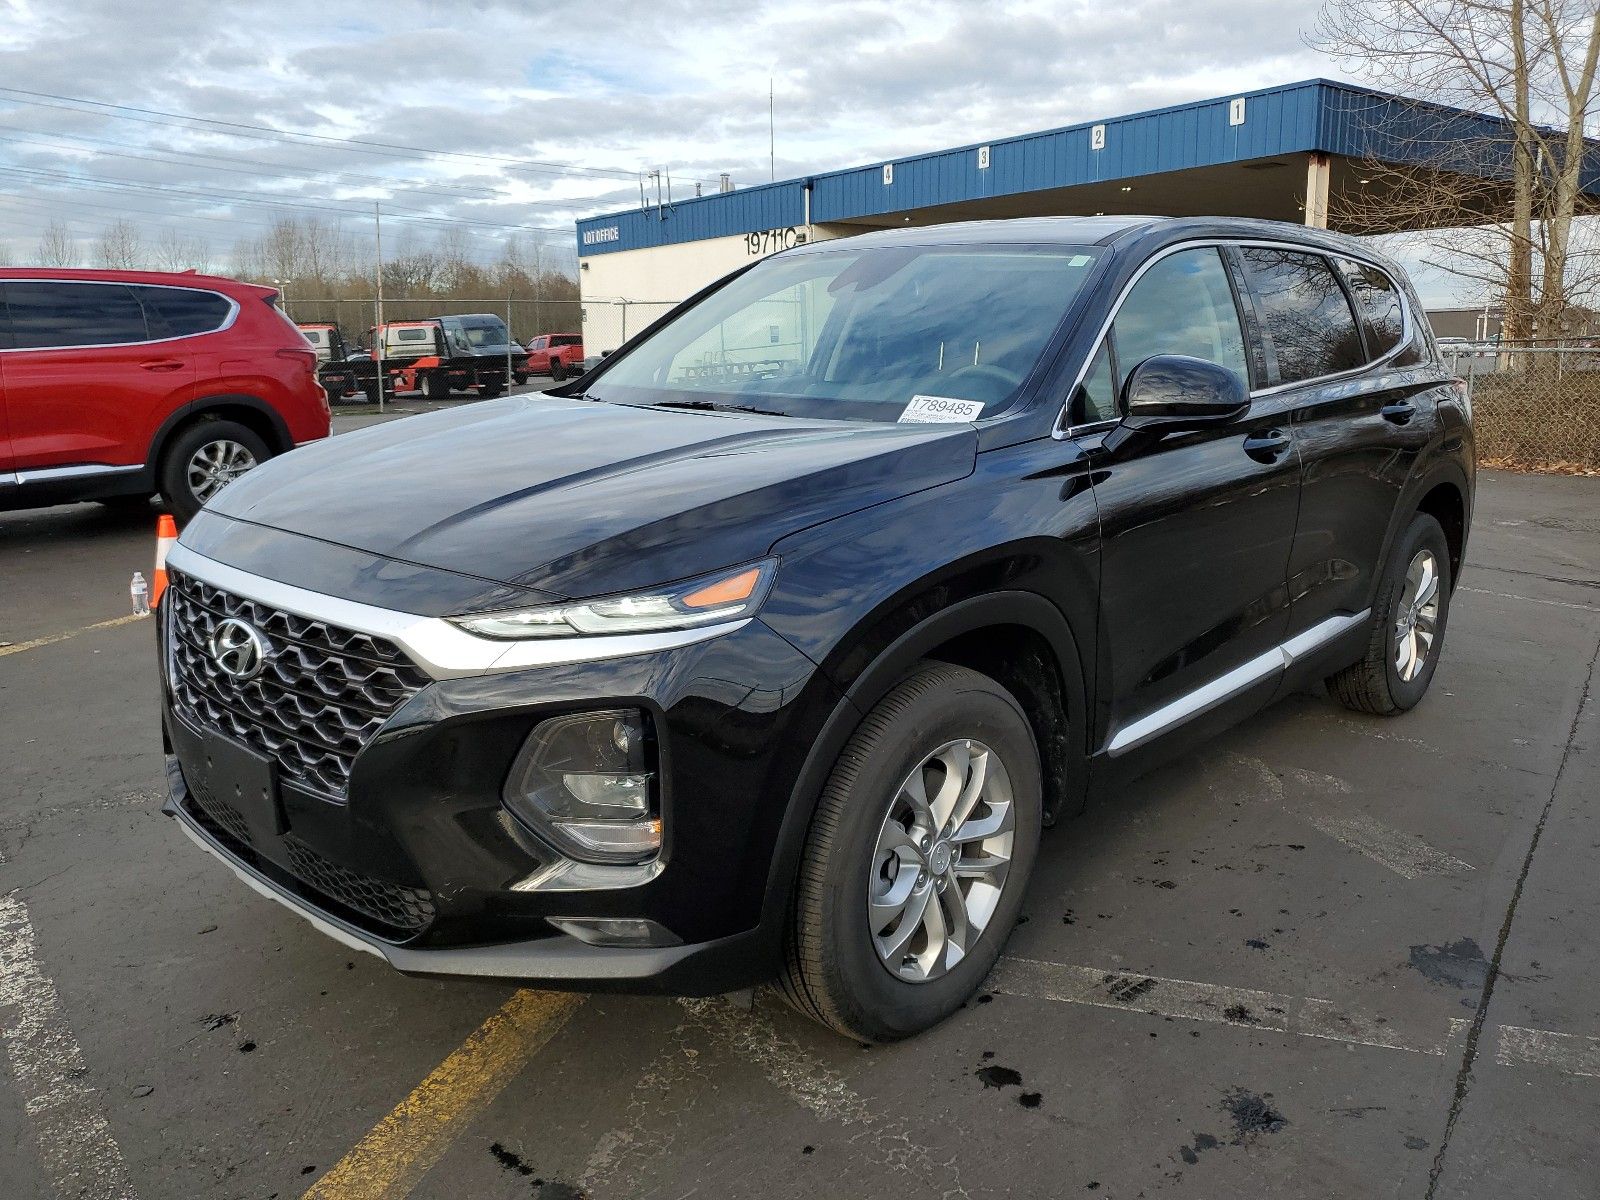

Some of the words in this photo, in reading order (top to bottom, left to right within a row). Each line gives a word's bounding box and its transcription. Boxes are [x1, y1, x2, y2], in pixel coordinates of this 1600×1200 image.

[1235, 103, 1240, 120] 1
[1095, 129, 1101, 144] 2
[981, 150, 987, 164] 3
[885, 167, 891, 181] 4
[583, 231, 595, 244] LOT
[596, 227, 619, 242] OFFICE
[912, 398, 976, 416] 1789485
